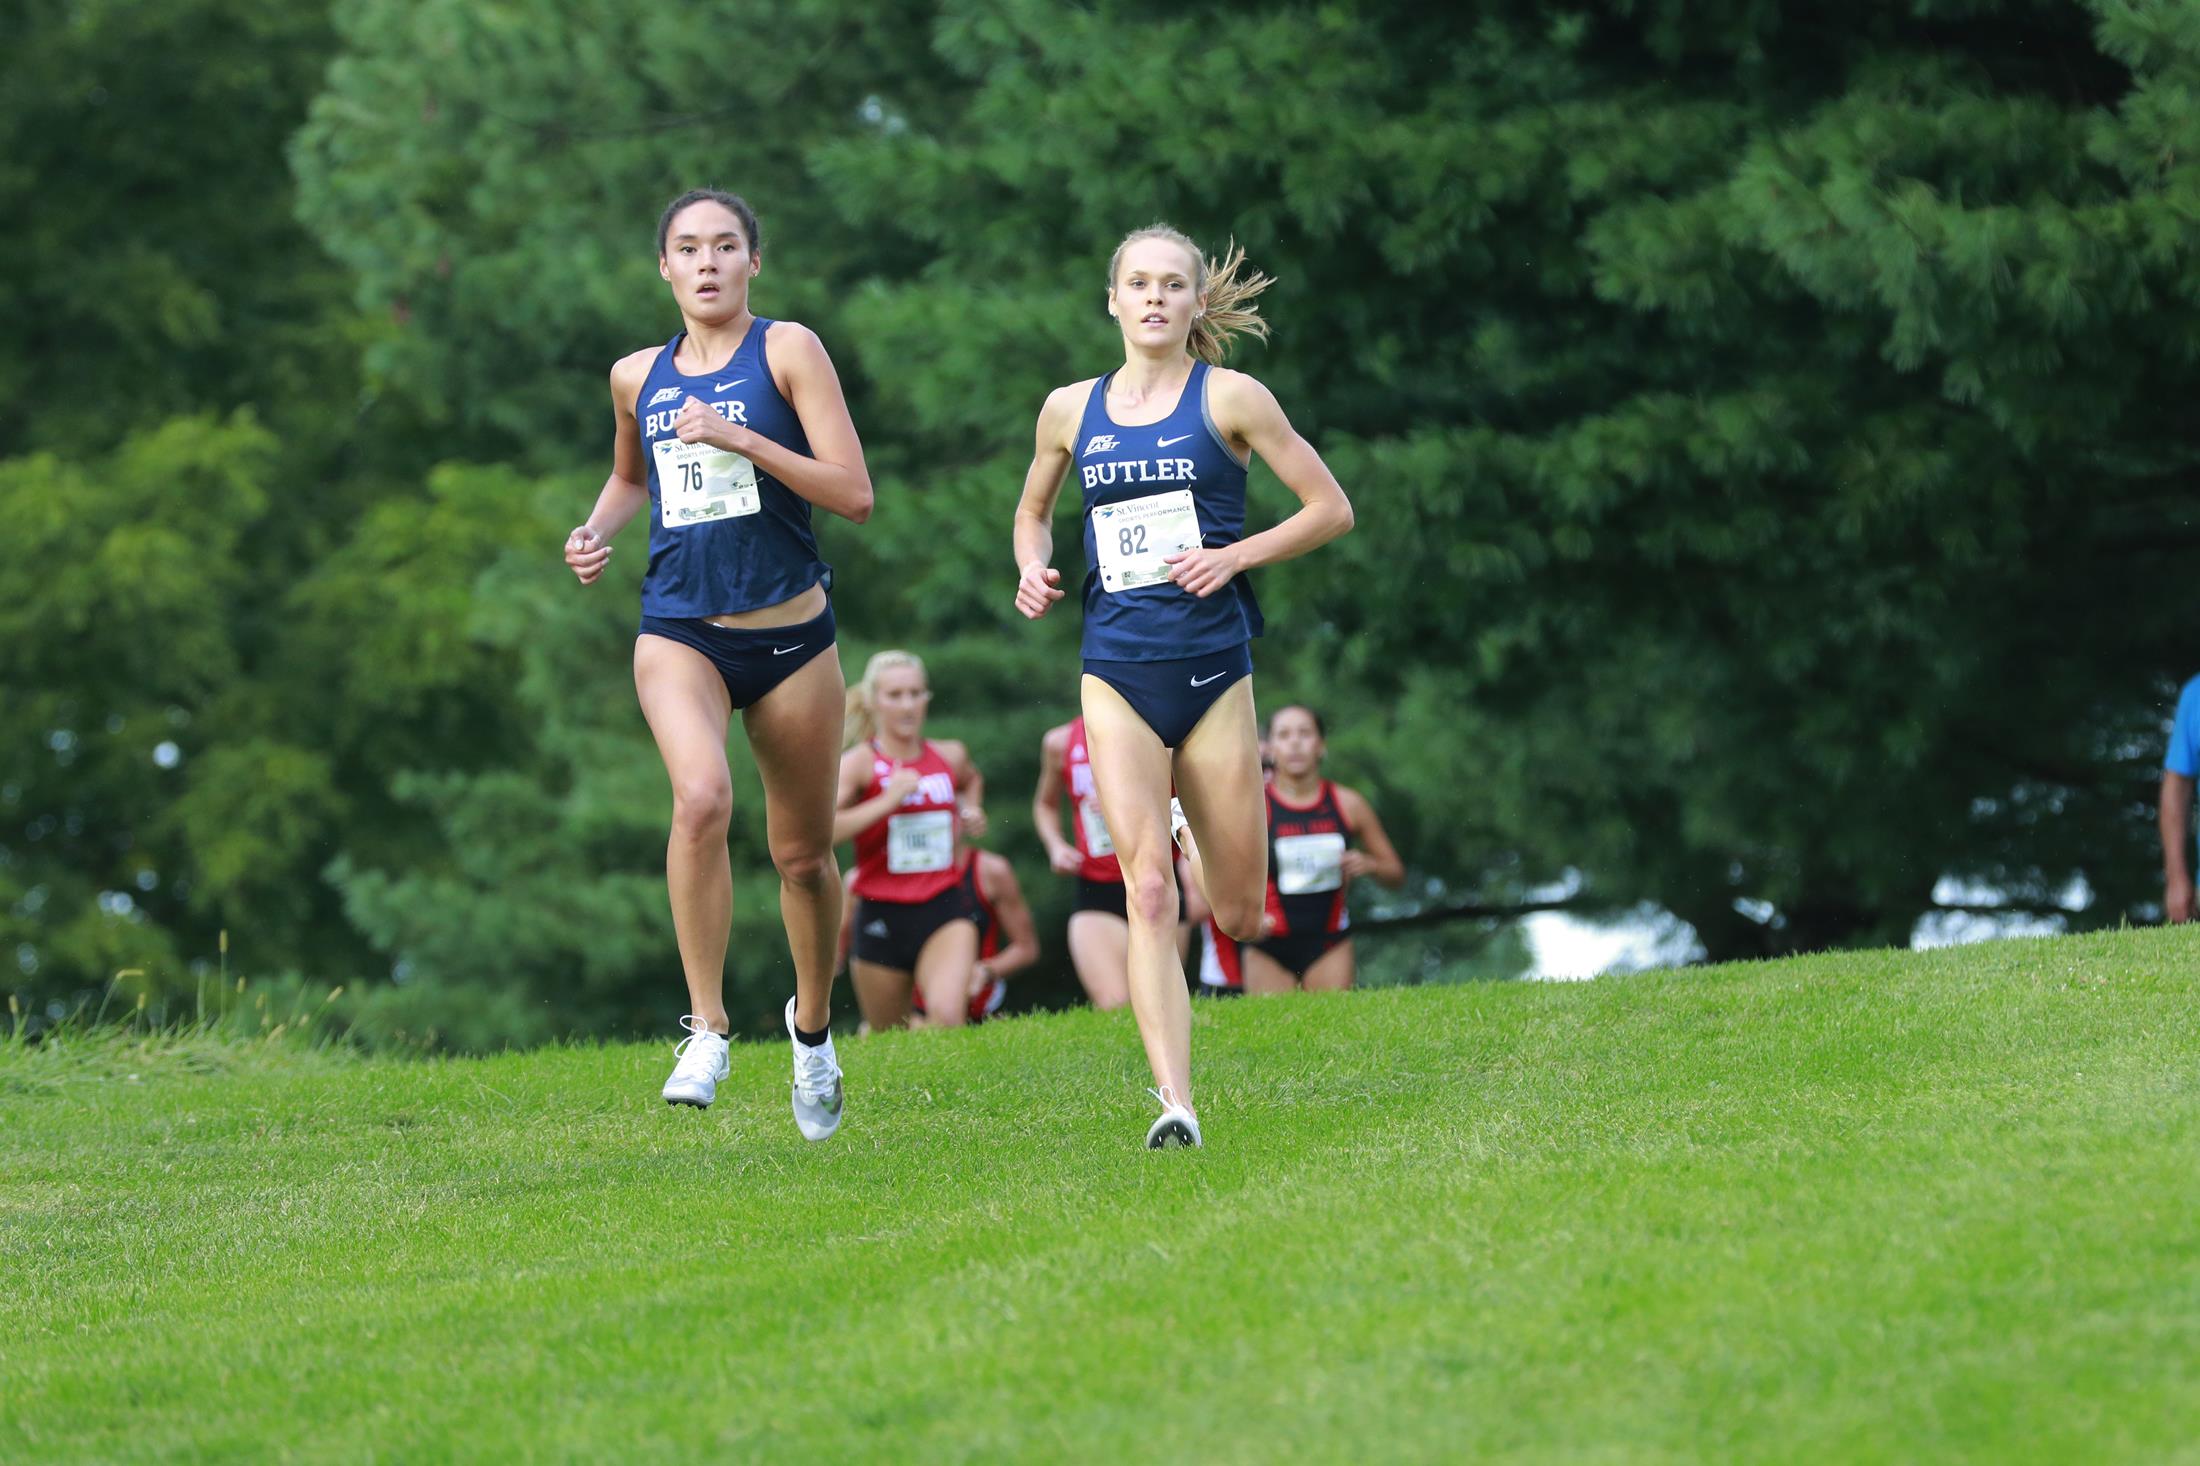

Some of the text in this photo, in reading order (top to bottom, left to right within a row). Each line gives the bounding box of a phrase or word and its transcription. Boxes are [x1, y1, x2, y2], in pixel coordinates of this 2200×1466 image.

[646, 401, 747, 438] BUER
[678, 461, 703, 493] 76
[1083, 458, 1197, 489] BUTLER
[1143, 505, 1191, 519] PERFORMANCE
[1118, 524, 1148, 556] 82
